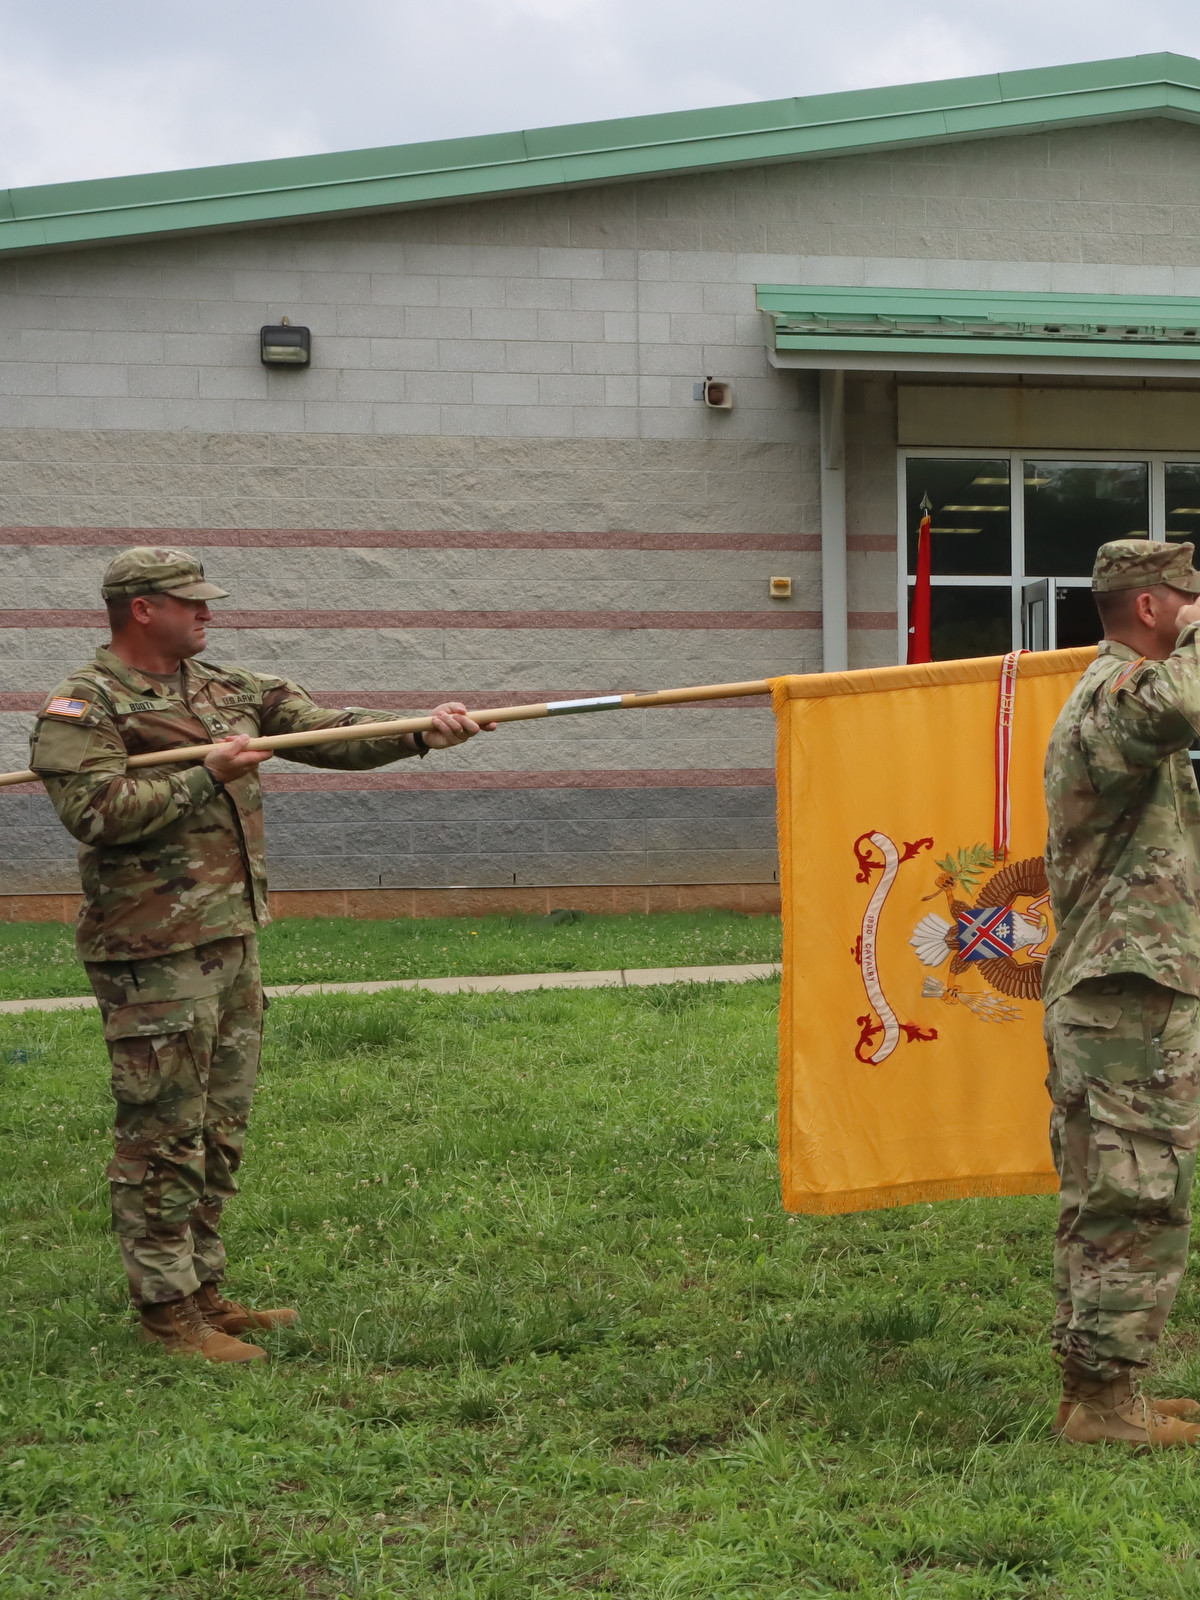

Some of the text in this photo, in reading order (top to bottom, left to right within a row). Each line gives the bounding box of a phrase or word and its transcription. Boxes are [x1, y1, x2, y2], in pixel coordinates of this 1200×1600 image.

[237, 695, 256, 703] ARMY
[865, 915, 876, 982] 183D CAVALRY
